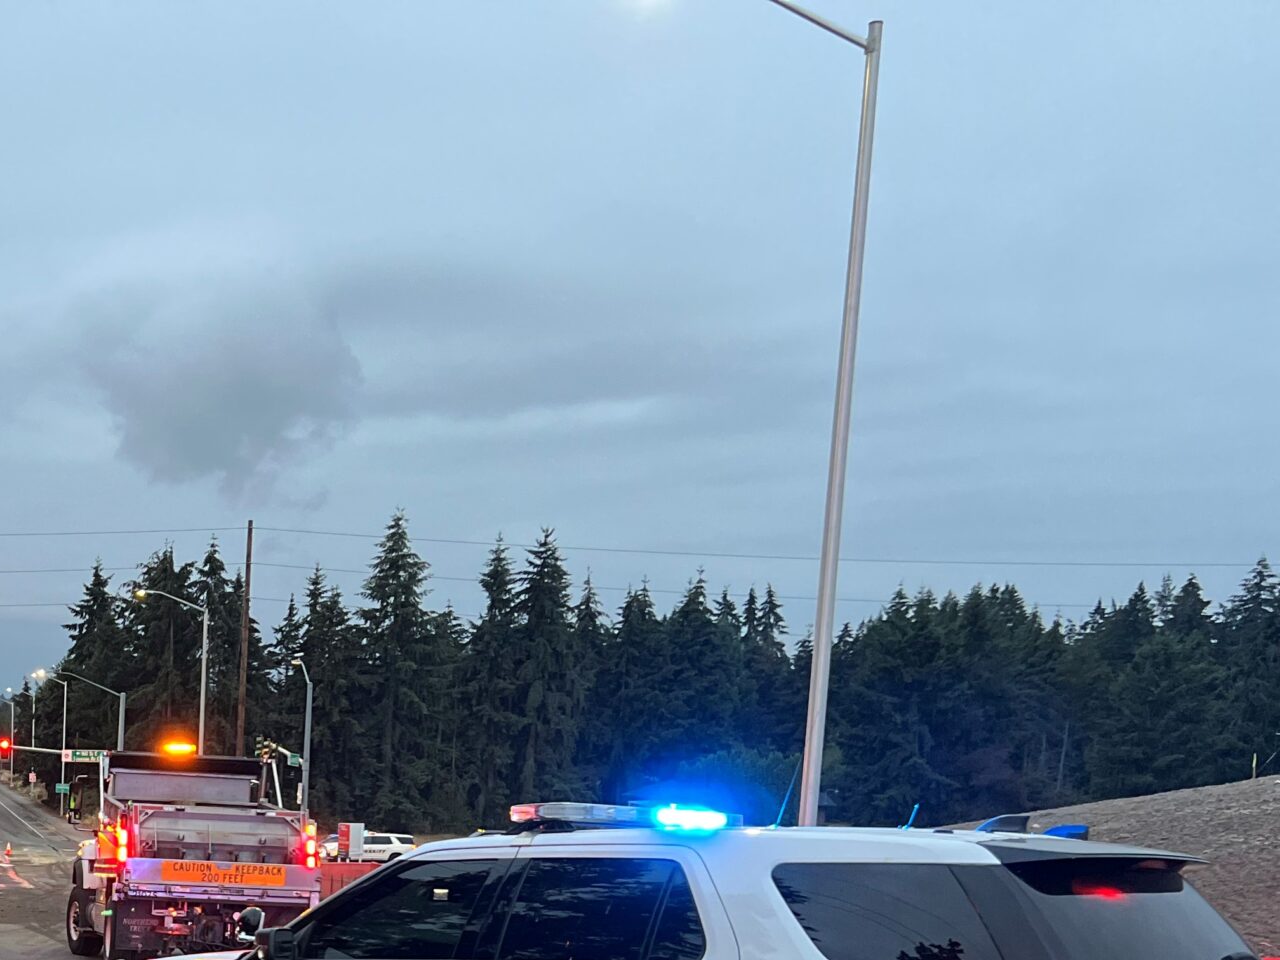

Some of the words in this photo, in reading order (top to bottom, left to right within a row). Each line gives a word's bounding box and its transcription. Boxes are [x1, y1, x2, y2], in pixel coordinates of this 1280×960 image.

[173, 862, 212, 872] CAUTION
[235, 865, 283, 876] KEEPBACK
[201, 873, 220, 882] 200
[222, 874, 244, 883] FEET
